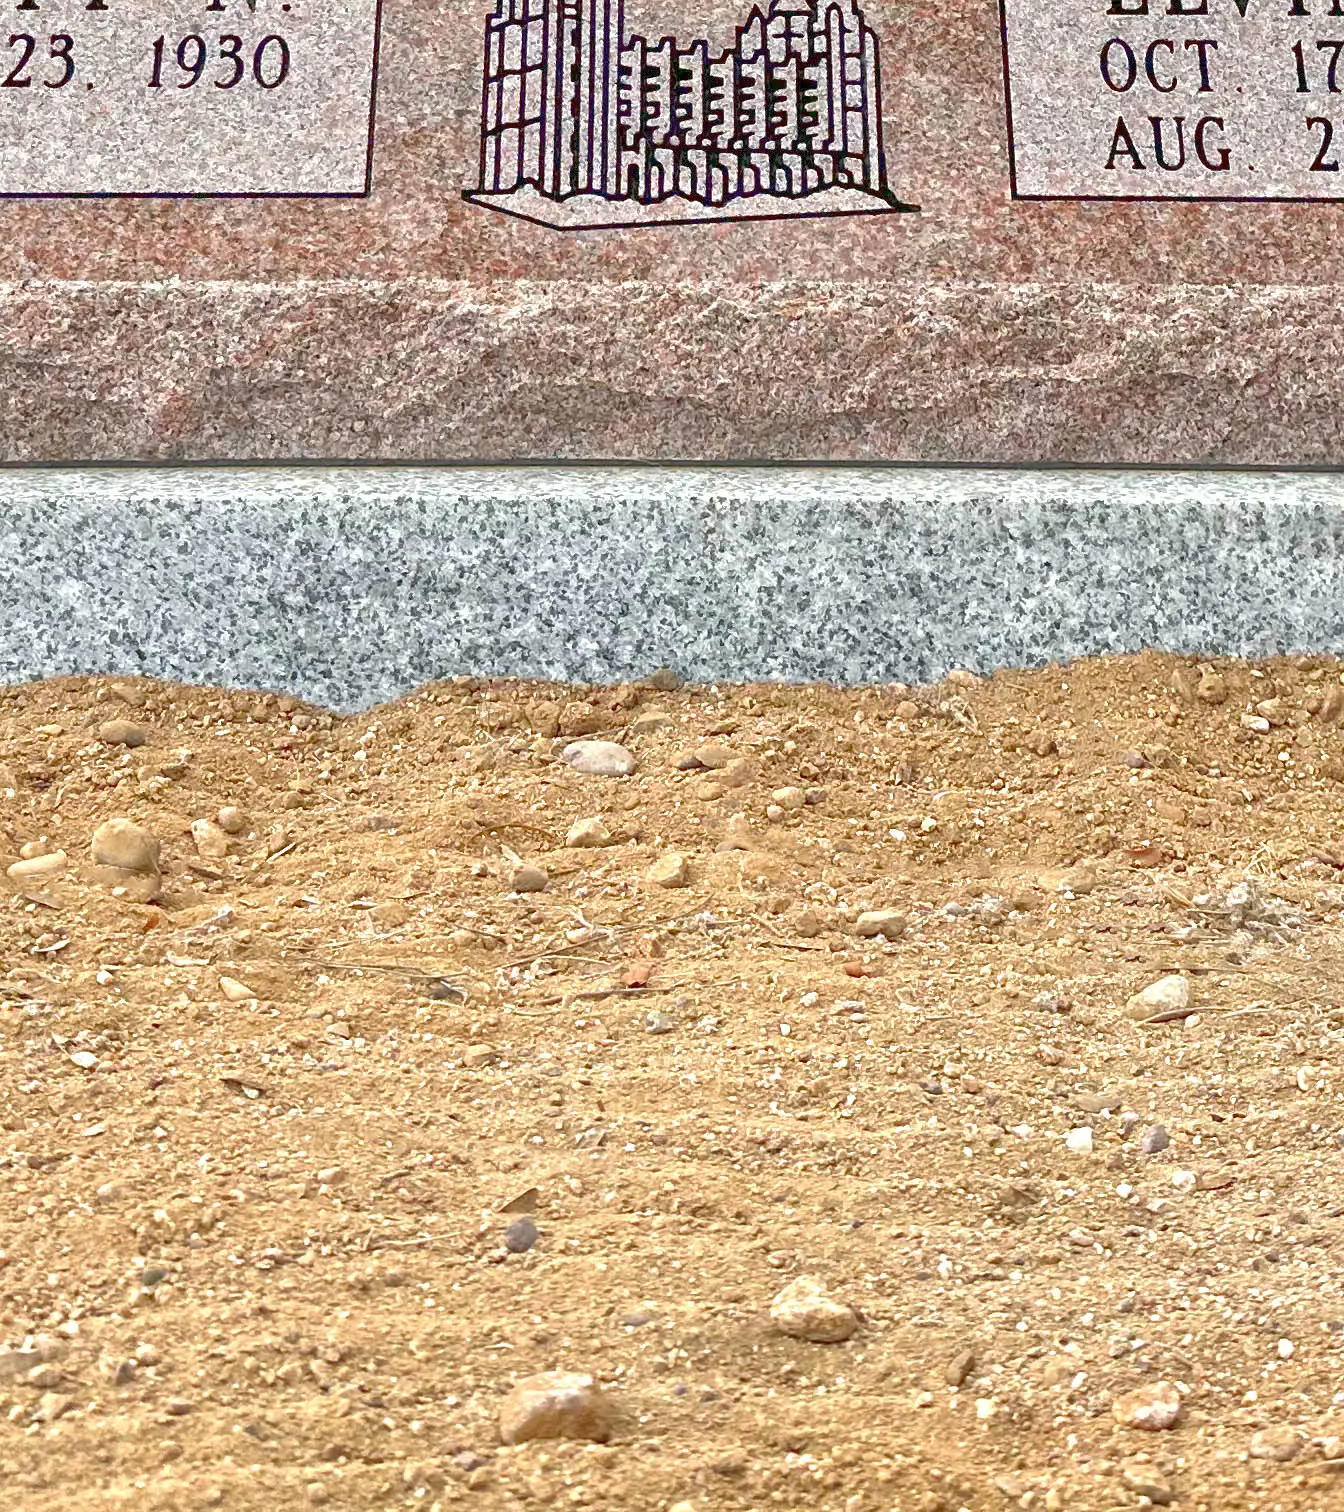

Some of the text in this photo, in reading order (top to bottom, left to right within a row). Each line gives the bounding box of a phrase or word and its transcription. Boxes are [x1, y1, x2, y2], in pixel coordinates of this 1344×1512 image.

[148, 35, 289, 89] 1930
[1100, 37, 1242, 93] OCT.
[1105, 116, 1254, 172] AUG.
